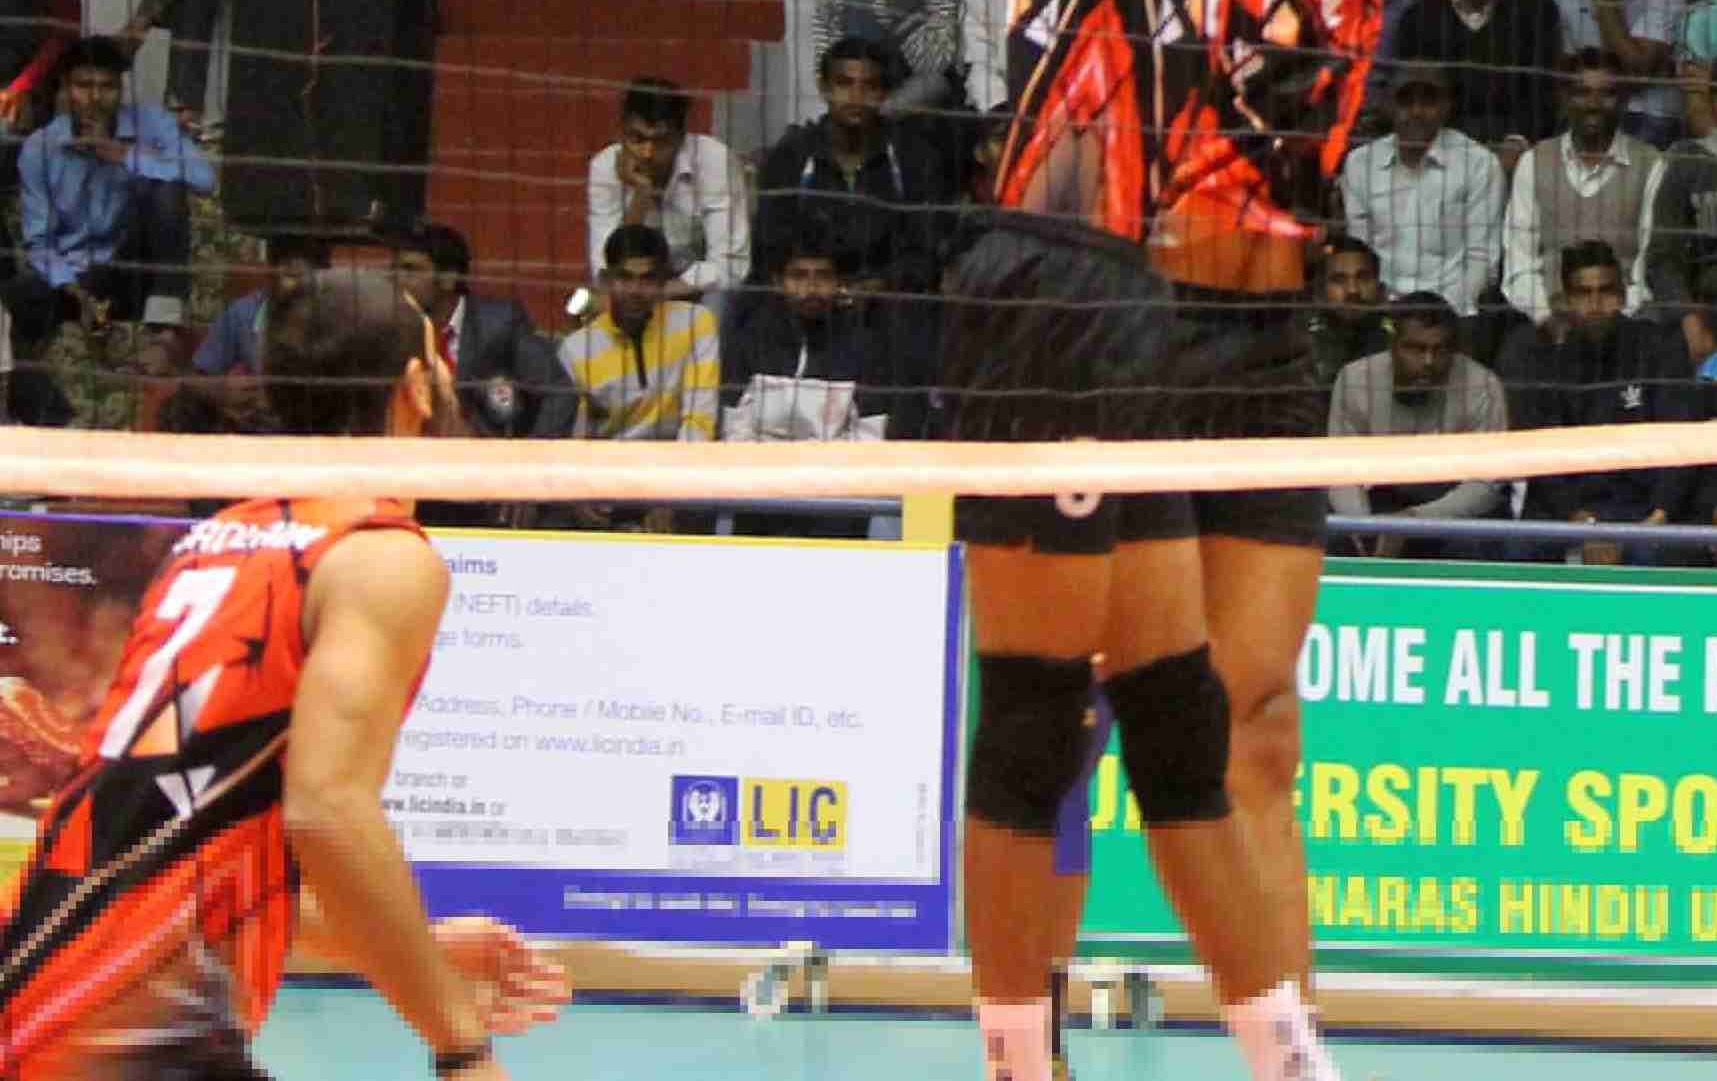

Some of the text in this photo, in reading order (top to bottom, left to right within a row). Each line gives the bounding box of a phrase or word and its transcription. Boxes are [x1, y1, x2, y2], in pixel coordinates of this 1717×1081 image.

[452, 591, 597, 621] (NEFT) details.
[98, 564, 239, 760] 7
[1296, 622, 1427, 705] OME
[1443, 627, 1551, 708] ALL
[1568, 632, 1683, 713] THE
[513, 695, 577, 719] Phone
[598, 699, 666, 721] Mobile
[721, 703, 786, 726] E-mail
[503, 734, 528, 751] on
[751, 785, 838, 843] LIC
[1498, 877, 1669, 941] HINDU
